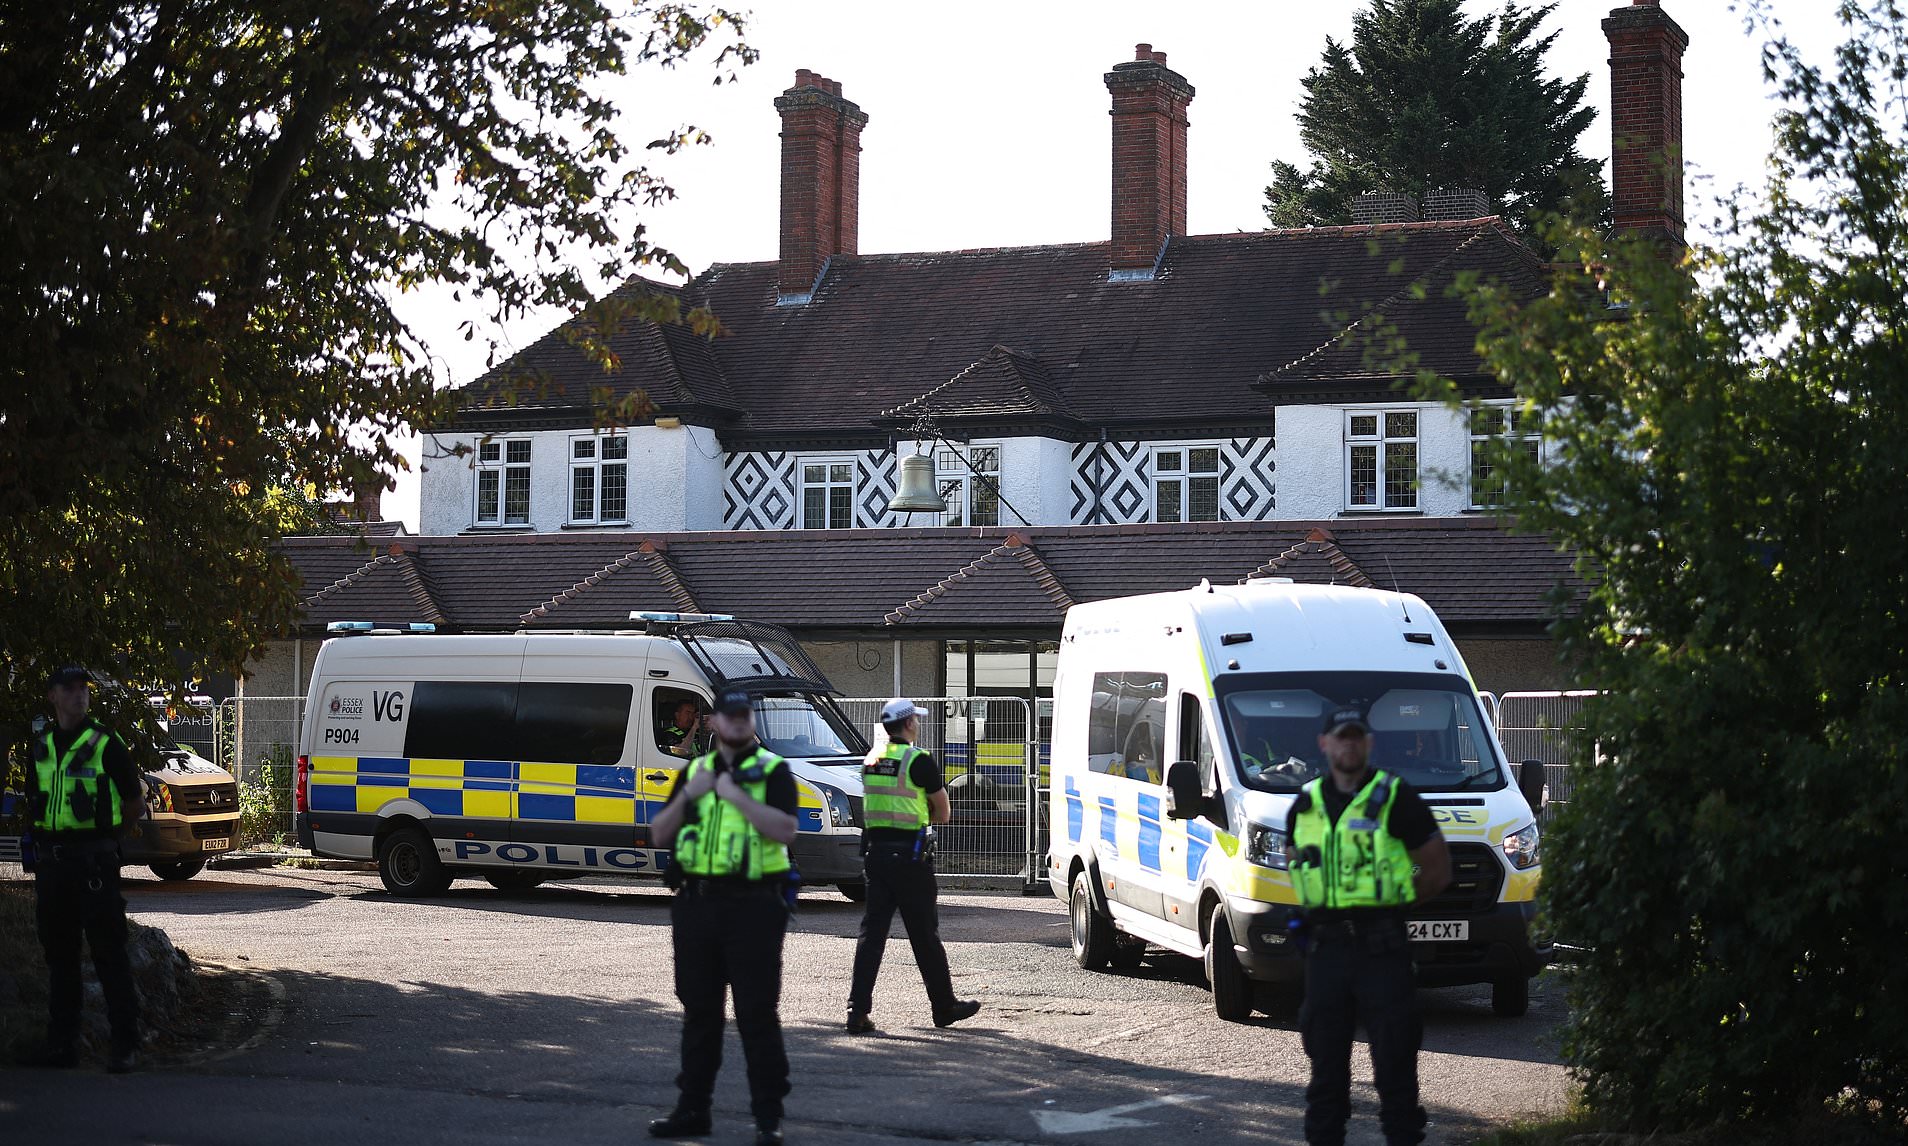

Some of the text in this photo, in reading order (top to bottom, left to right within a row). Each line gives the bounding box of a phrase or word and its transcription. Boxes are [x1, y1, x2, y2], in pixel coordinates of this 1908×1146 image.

[342, 698, 364, 706] ESSEX
[373, 691, 404, 721] VG
[158, 714, 213, 727] NDARD
[325, 729, 359, 743] P904
[1408, 923, 1463, 938] 24 CXT
